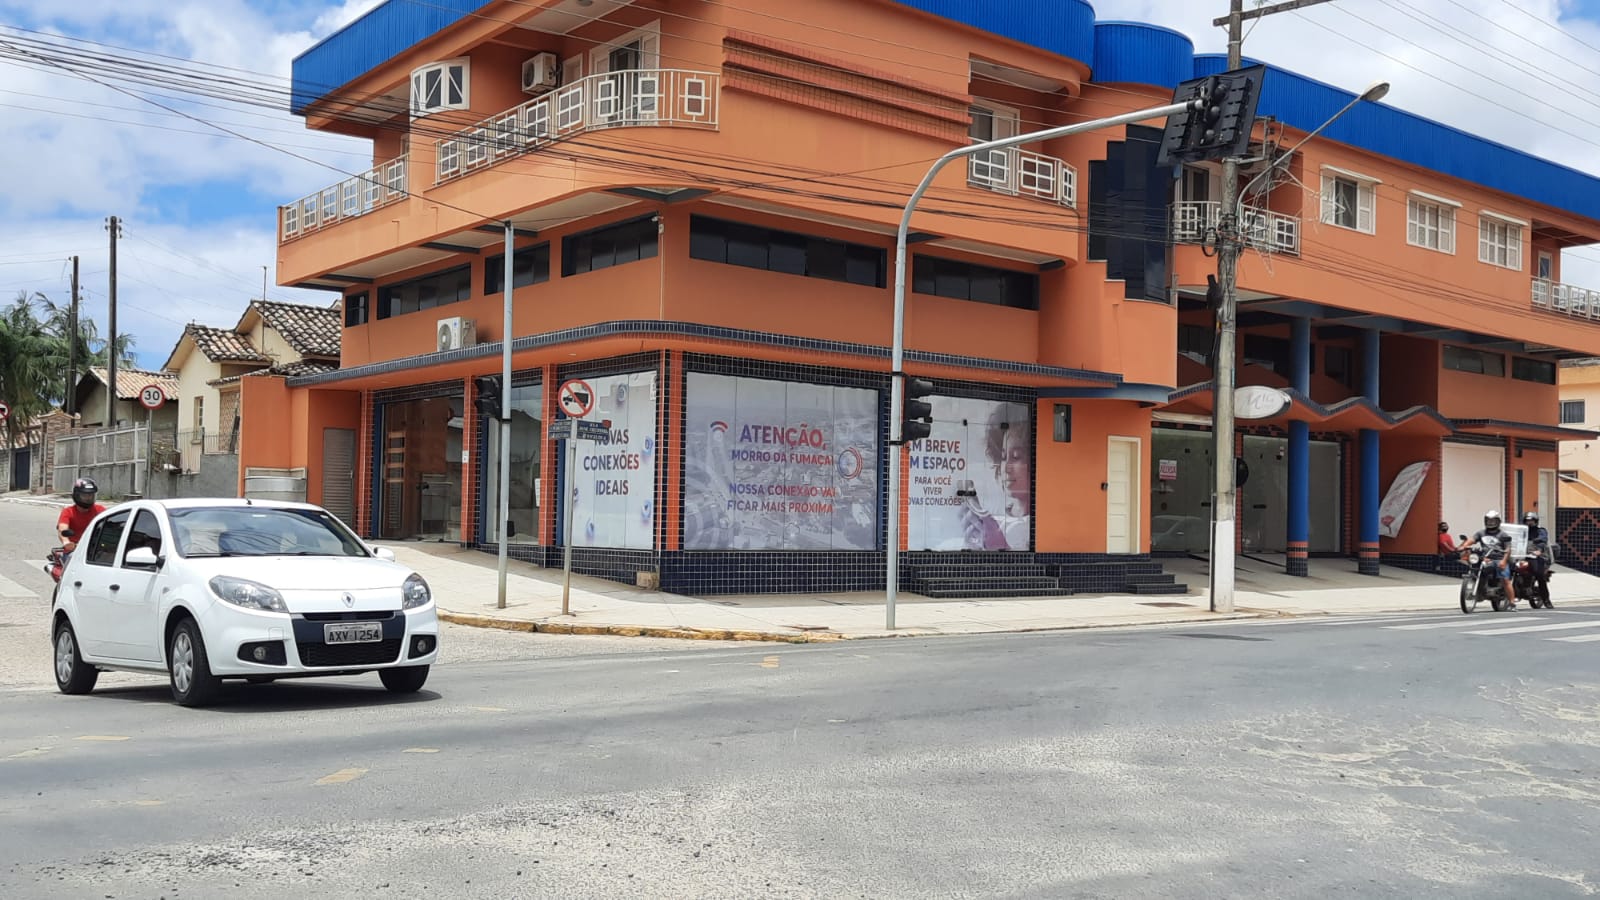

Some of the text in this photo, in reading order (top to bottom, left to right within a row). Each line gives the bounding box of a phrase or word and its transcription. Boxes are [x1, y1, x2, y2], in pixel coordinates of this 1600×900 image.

[144, 390, 160, 401] 30
[740, 423, 827, 451] ATENÇÃO,
[925, 439, 961, 454] BREVE
[583, 449, 640, 471] CONEXÕES
[731, 449, 771, 462] MORRO
[773, 452, 787, 463] DA
[922, 456, 966, 473] ESPAÇO
[595, 479, 629, 496] IDEAIS
[914, 476, 932, 485] PARA
[729, 483, 765, 496] NOSSA
[767, 483, 818, 497] CONEXÃO
[923, 486, 943, 496] VIVER
[727, 499, 759, 512] FICAR
[761, 501, 786, 513] MAIS
[925, 495, 962, 506] CONEXÕES
